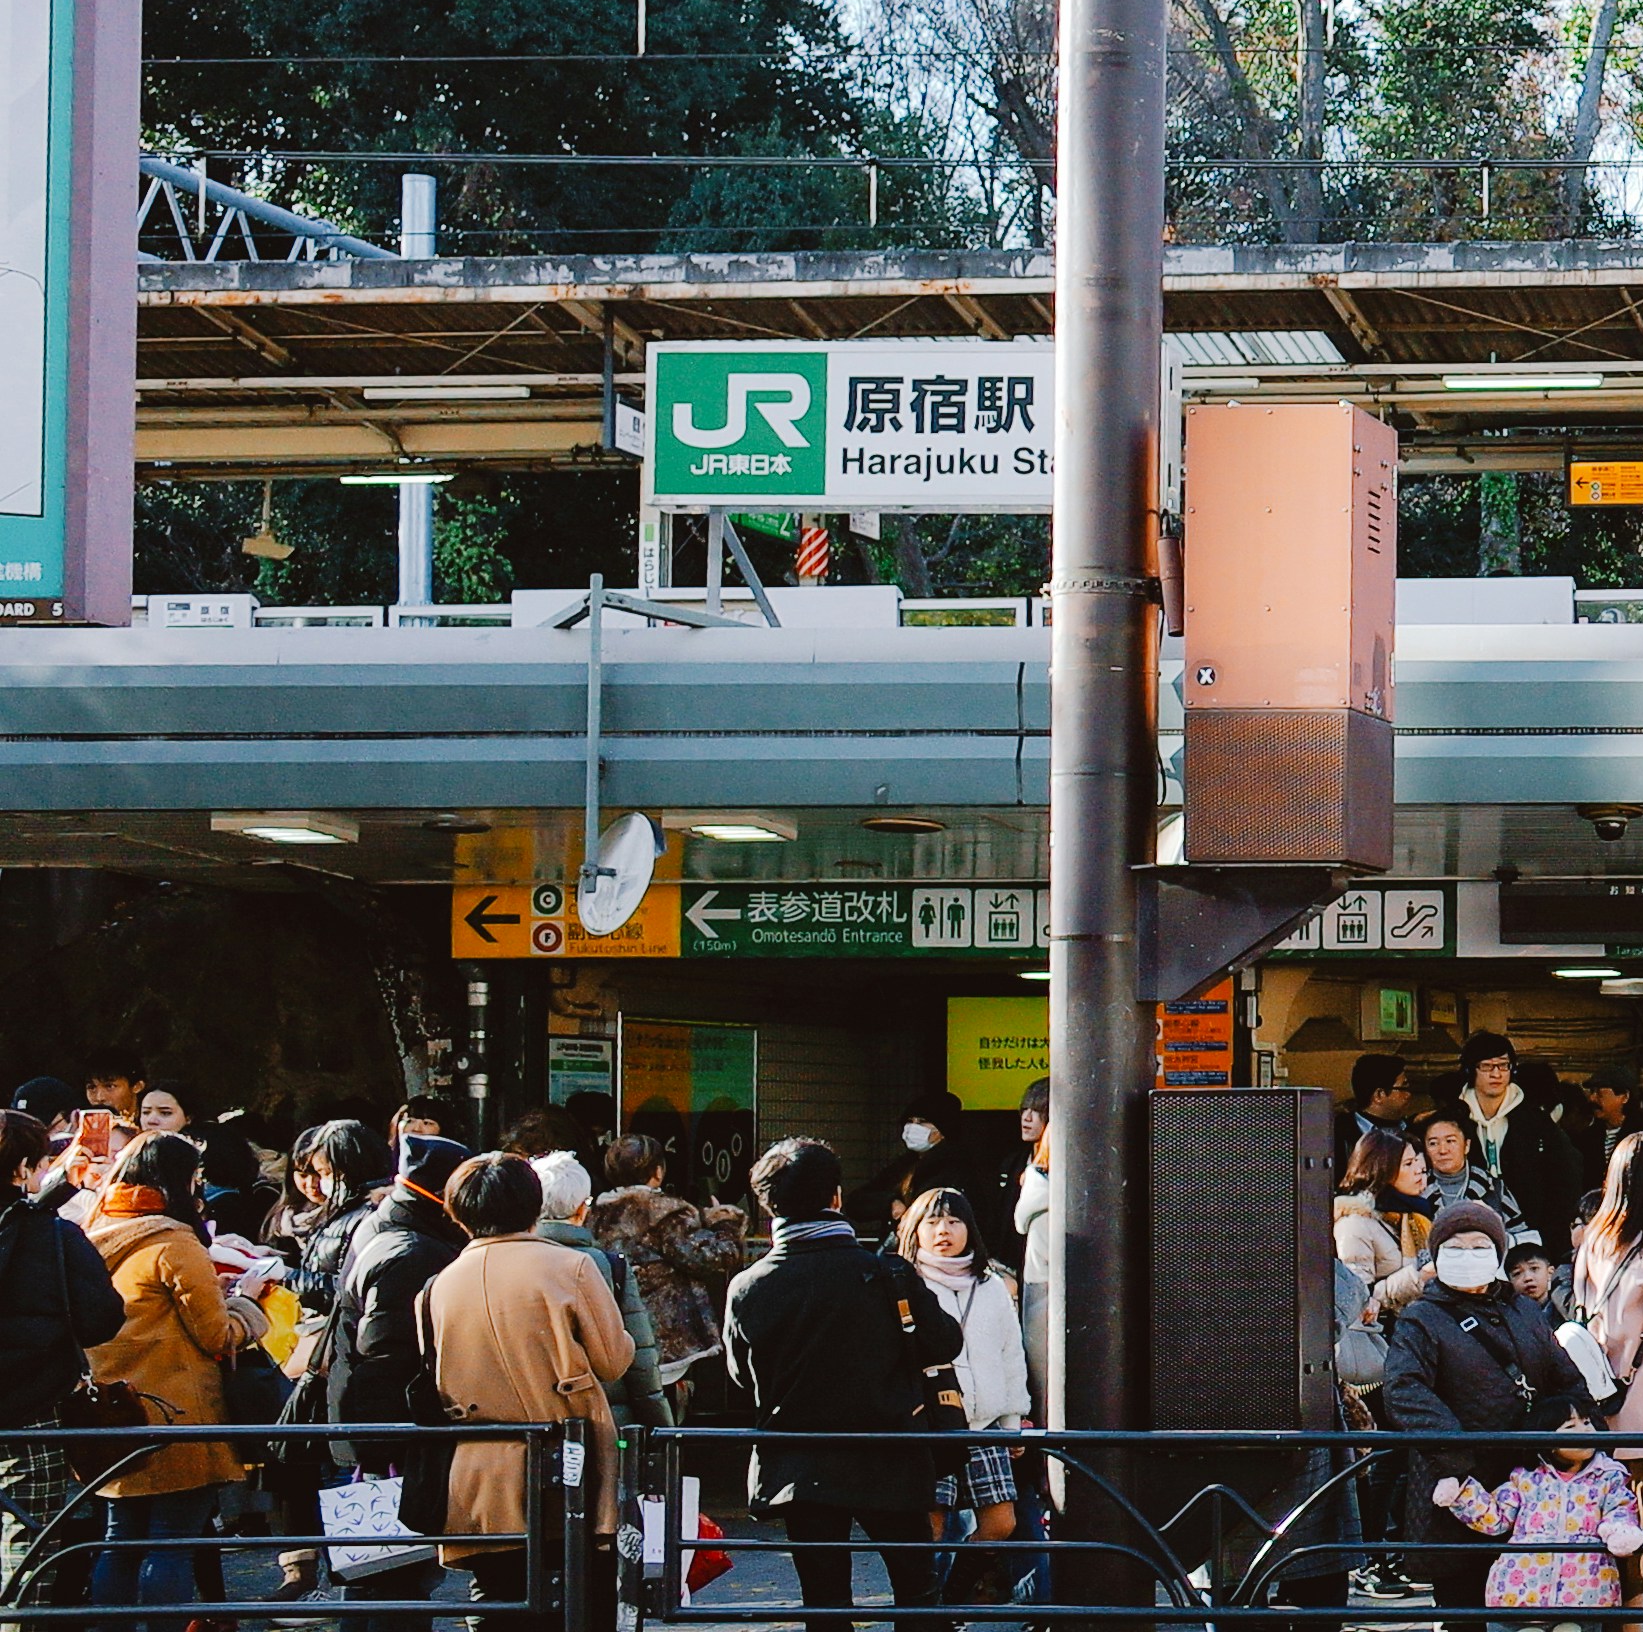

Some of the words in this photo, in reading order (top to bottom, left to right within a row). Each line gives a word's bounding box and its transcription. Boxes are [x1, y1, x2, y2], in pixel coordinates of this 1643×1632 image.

[672, 372, 812, 449] JR
[843, 375, 1036, 435] 原宿駅
[689, 453, 793, 477] JR東日本
[841, 447, 1000, 483] Harajuku
[51, 603, 64, 617] 5
[747, 890, 908, 924] 表参道改札
[569, 942, 638, 954] Fukutoshin
[640, 943, 667, 954] Line
[693, 939, 737, 952] (150m)
[752, 928, 837, 944] Omotesandō
[842, 928, 903, 943] Entrance
